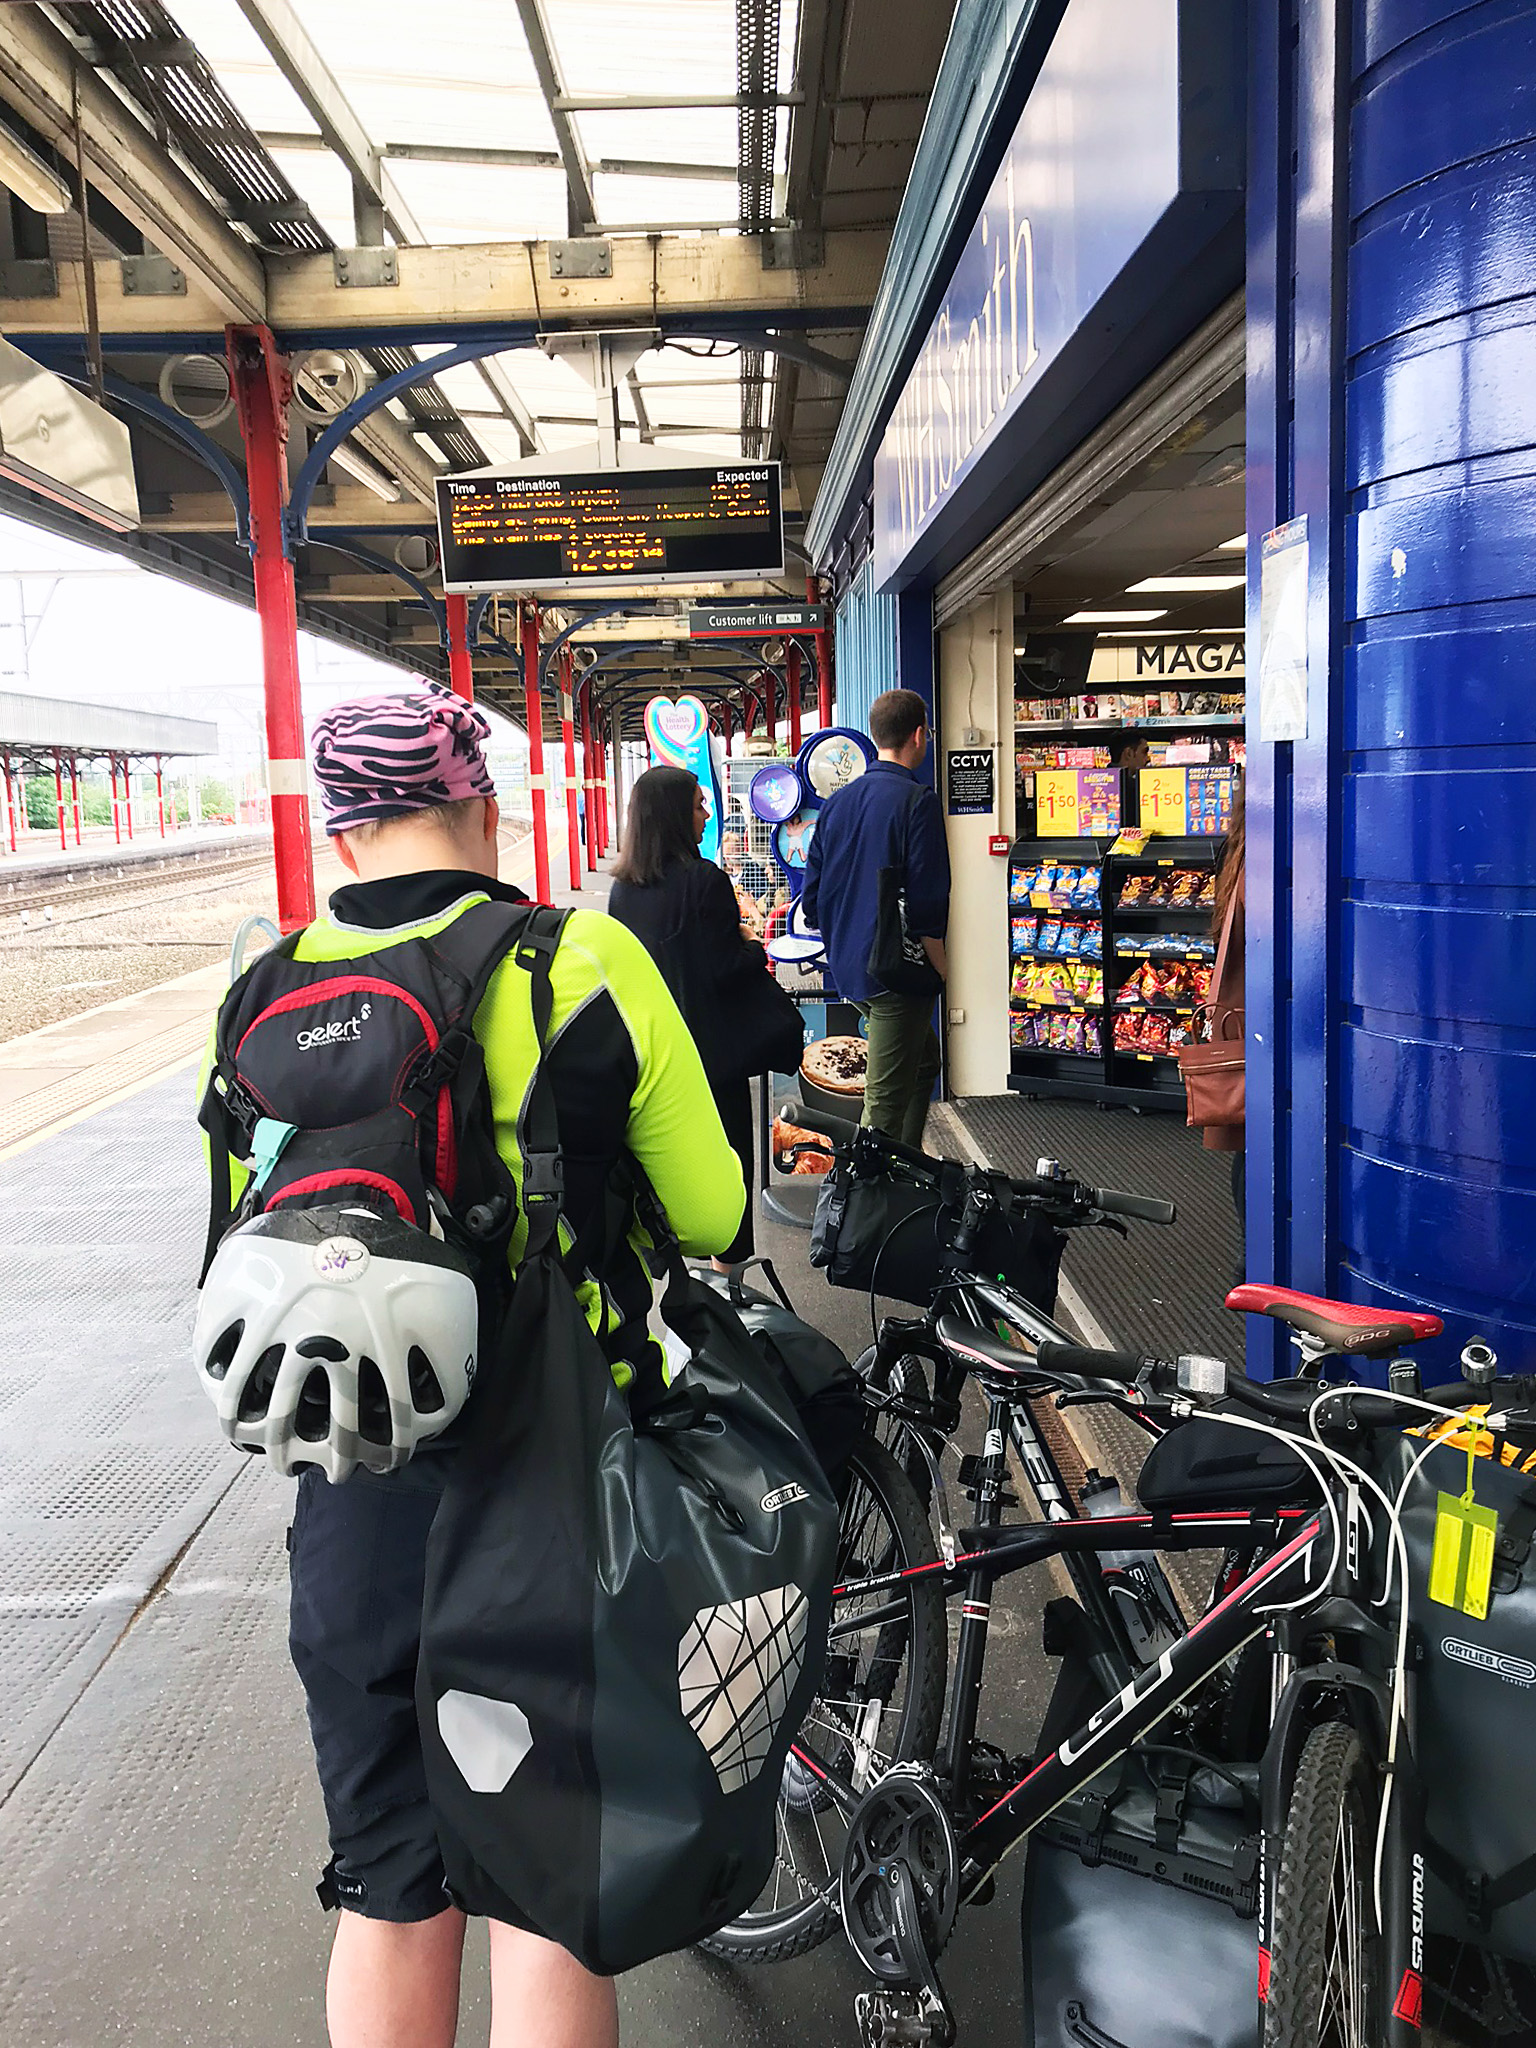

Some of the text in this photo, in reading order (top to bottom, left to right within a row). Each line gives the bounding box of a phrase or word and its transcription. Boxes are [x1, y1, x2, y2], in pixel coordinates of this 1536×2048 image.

[448, 469, 769, 495] Time Destination Expected
[708, 613, 773, 627] Customer lift
[1136, 643, 1245, 675] MAGA
[951, 755, 991, 768] CCTV
[1048, 782, 1056, 793] 2
[1153, 779, 1161, 791] 2
[296, 1016, 361, 1051] gelert
[1446, 1643, 1494, 1666] ORTLIEB
